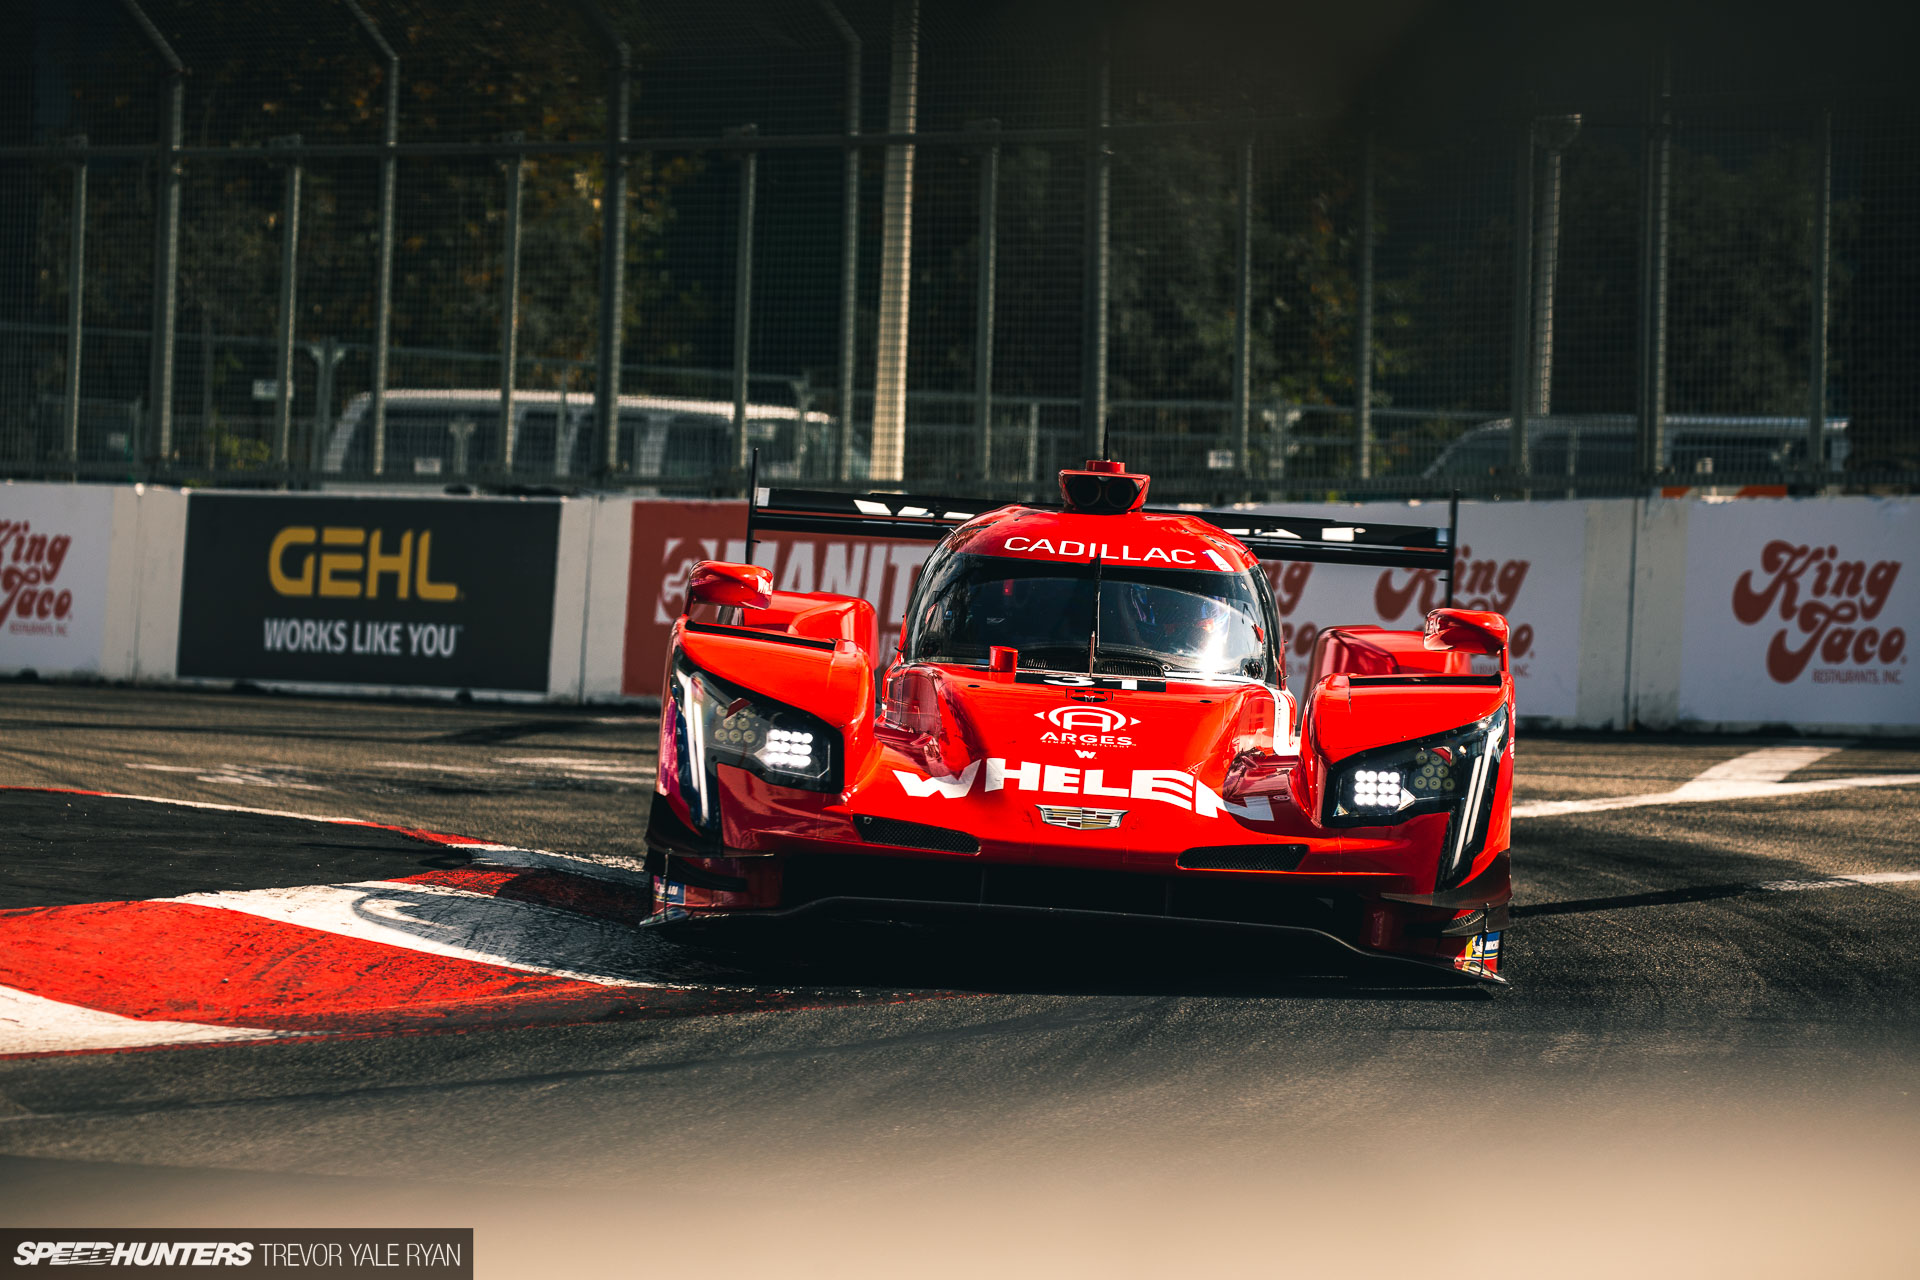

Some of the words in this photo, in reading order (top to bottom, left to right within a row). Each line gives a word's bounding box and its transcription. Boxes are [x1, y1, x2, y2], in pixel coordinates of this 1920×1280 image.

[268, 526, 458, 601] GEHL
[1004, 536, 1196, 564] CADILLAC
[1731, 539, 1903, 626] King
[263, 617, 348, 653] WORKS
[352, 620, 402, 655] LIKE
[407, 622, 456, 658] YOU
[1765, 599, 1906, 684] Taco
[1040, 731, 1133, 746] ARGES
[893, 758, 1275, 822] WHELEN
